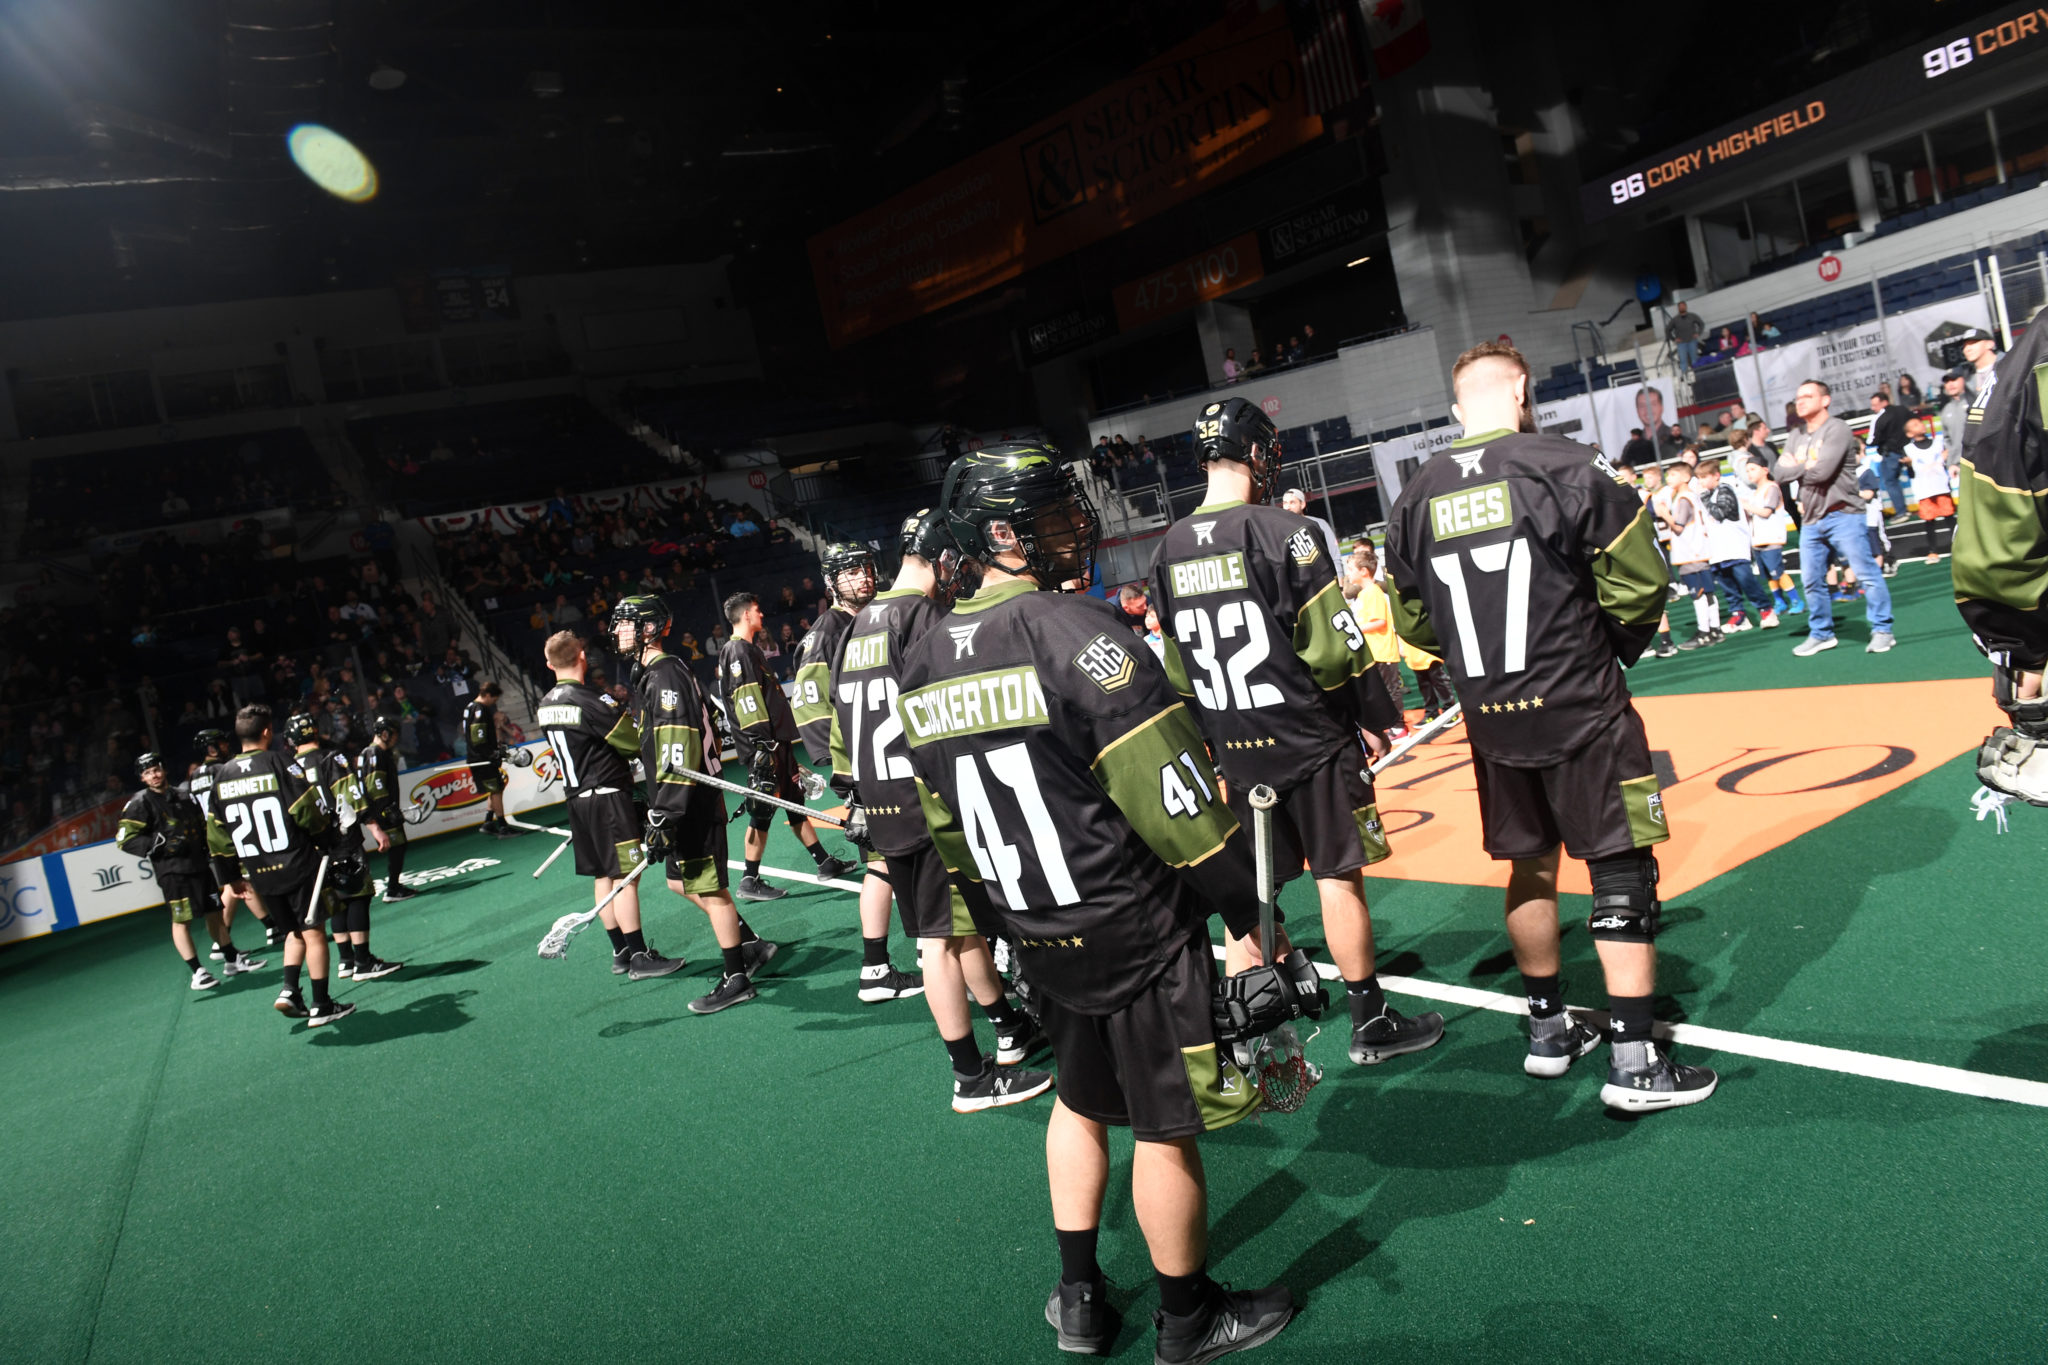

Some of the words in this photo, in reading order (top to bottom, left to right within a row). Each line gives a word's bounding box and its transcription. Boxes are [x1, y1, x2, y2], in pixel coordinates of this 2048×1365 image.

[1922, 36, 1974, 79] 96
[1084, 58, 1203, 150] SEGAR
[1093, 60, 1295, 193] SCIORTINO
[1610, 172, 1646, 205] 96
[1646, 149, 1702, 189] CORY
[1707, 101, 1826, 164] HIGHFIELD
[1134, 246, 1239, 311] 475-1100
[1199, 420, 1219, 439] 32
[1263, 399, 1279, 414] 102
[1435, 487, 1505, 536] REES
[1288, 527, 1315, 558] 585
[1174, 556, 1244, 596] BRIDLE
[1430, 538, 1532, 678] 17
[845, 635, 885, 671] PRATT
[1077, 635, 1126, 681] 585
[1174, 601, 1285, 711] 32
[661, 689, 678, 706] 585
[739, 695, 758, 715] 16
[793, 680, 820, 709] 29
[838, 677, 915, 782] 72
[547, 730, 579, 787] 11
[661, 743, 684, 767] 26
[219, 774, 275, 800] BENNETT
[375, 778, 383, 790] 5
[1161, 751, 1213, 817] 41
[225, 796, 289, 858] 20
[955, 742, 1081, 911] 41
